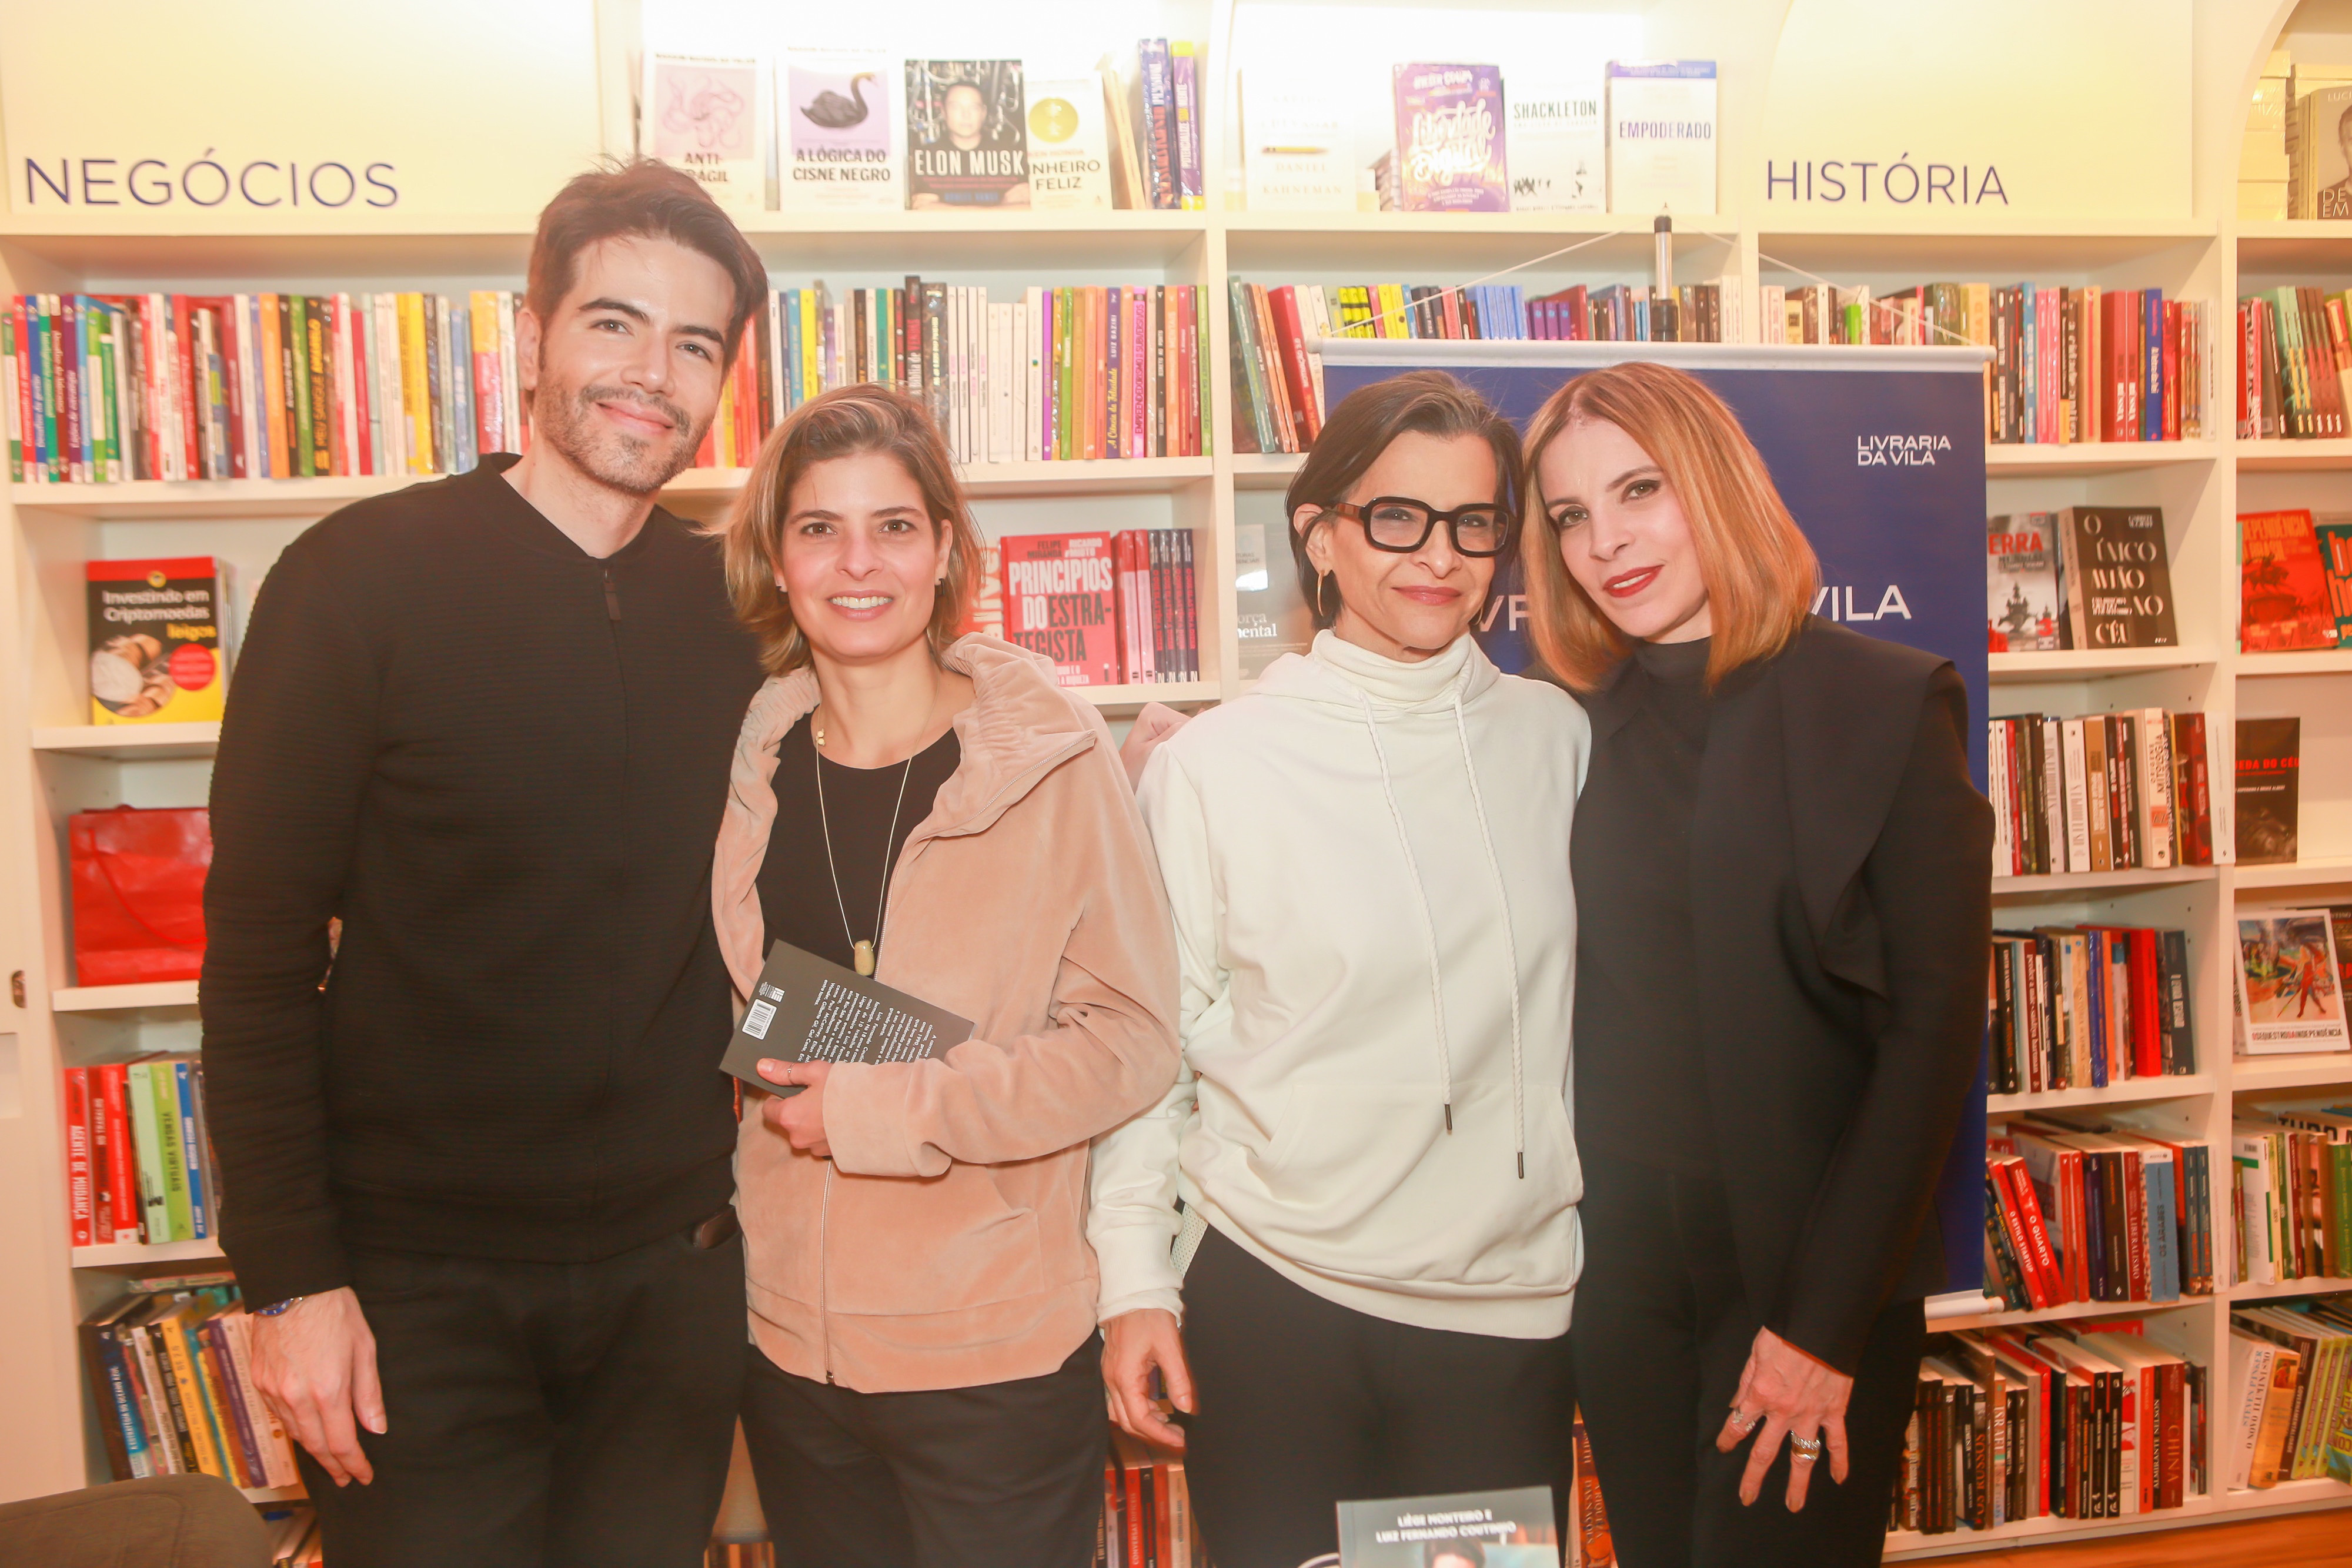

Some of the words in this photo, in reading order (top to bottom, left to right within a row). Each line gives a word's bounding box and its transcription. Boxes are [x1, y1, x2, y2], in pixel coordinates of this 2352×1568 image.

[2327, 91, 2352, 102] LUCI
[1513, 101, 1598, 119] SHACKLETON
[1412, 98, 1496, 149] Liberdade
[1619, 121, 1712, 140] EMPODERADO
[796, 151, 807, 162] A
[809, 145, 863, 163] LÓGICA
[864, 149, 886, 163] DO
[914, 150, 963, 176] ELON
[969, 149, 1025, 176] MUSK
[1410, 136, 1494, 187] Digital
[792, 168, 836, 182] CISNE
[840, 168, 891, 182] NEGRO
[1275, 162, 1327, 173] DANIEL
[25, 148, 399, 209] NEGÓCIOS
[1035, 177, 1082, 190] FELIZ
[1766, 152, 2009, 205] HISTÓRIA
[1262, 185, 1342, 195] KAHNEMAN
[1135, 304, 1144, 352] SUBVERSIVOS
[1108, 367, 1118, 403] Felicidade
[1202, 379, 1208, 389] DA
[312, 375, 326, 420] SANGUE
[1135, 358, 1144, 434] EMPREENDEDORISMO
[1110, 404, 1118, 412] da
[314, 422, 327, 447] MEU
[1107, 414, 1118, 439] Ciência
[1108, 439, 1117, 449] A
[1857, 434, 1952, 451] LIVRARIA
[1857, 451, 1886, 466] DA
[1888, 451, 1936, 466] VILA
[2083, 514, 2102, 536] O
[1037, 540, 1062, 549] FELIPE
[1068, 537, 1102, 547] RICARDO
[1988, 531, 2043, 556] ERRA
[2096, 537, 2157, 562] ÚNICO
[1027, 550, 1063, 559] MIRANDA
[102, 588, 184, 605] Investindo
[184, 590, 210, 603] em
[1810, 584, 1913, 621] VILA
[2133, 594, 2164, 617] NO
[103, 604, 211, 625] Criptomoedas
[1021, 594, 1048, 631] DO
[1048, 593, 1111, 628] ESTRA-
[1237, 613, 1268, 627] orça
[166, 623, 217, 641] leigos
[2037, 617, 2054, 637] 3
[2095, 619, 2131, 644] CÉU
[2263, 758, 2278, 769] DO
[2280, 755, 2300, 768] CÉU
[2027, 954, 2038, 981] perder
[820, 979, 828, 991] entre
[823, 982, 836, 1000] Wonder,
[813, 991, 824, 1005] tantos.
[836, 987, 847, 1004] música,
[858, 995, 867, 1008] Liège
[816, 1001, 827, 1019] Gilberto
[838, 1000, 850, 1018] Rio-São
[845, 992, 860, 1021] promoveram
[884, 1007, 894, 1024] grande
[811, 1019, 819, 1028] Gil,
[824, 1005, 840, 1034] trabalharam
[833, 1018, 842, 1032] Paulo
[849, 1008, 861, 1029] Monteiro
[918, 1021, 927, 1032] anos
[2029, 1009, 2039, 1038] saidiya
[820, 1034, 827, 1043] em
[837, 1021, 847, 1039] eventos
[878, 1022, 887, 1037] porte.
[908, 1027, 917, 1038] leva
[800, 1038, 811, 1052] Costa,
[823, 1037, 834, 1055] também
[842, 1035, 850, 1045] Luiz
[884, 1031, 899, 1059] profissionais
[912, 1033, 923, 1046] 1990,
[924, 1039, 934, 1058] carreira
[797, 1052, 805, 1062] Eric
[813, 1044, 823, 1058] shows
[829, 1044, 839, 1058] festas
[834, 1045, 846, 1064] Fernan
[899, 1045, 908, 1060] nome.
[906, 1046, 916, 1064] mudou
[2031, 1038, 2040, 1074] hartman
[163, 1112, 178, 1147] VENDAS
[71, 1125, 86, 1158] AGENTE
[72, 1161, 86, 1172] DE
[166, 1151, 182, 1192] VIRTUAIS
[72, 1176, 89, 1220] MUDANÇA
[2029, 1215, 2037, 1223] O
[2011, 1218, 2024, 1241] ESTILO
[2019, 1242, 2034, 1273] STARTUP
[2032, 1225, 2050, 1266] QUARTO
[2129, 1216, 2141, 1280] LIBERALISMO
[2159, 1242, 2167, 1257] OS
[2044, 1268, 2059, 1297] REICH
[110, 1366, 123, 1381] AZUL
[113, 1382, 128, 1403] OCEANO
[2241, 1389, 2255, 1427] STEVEN
[2248, 1350, 2264, 1387] PINKER
[2247, 1414, 2259, 1441] NOVO
[2253, 1351, 2271, 1412] ILUMINISMO
[120, 1403, 129, 1411] DO
[122, 1411, 138, 1444] ESTRATÉGIA
[1994, 1405, 2006, 1452] ISRAEL
[2153, 1399, 2161, 1442] NELSON
[1976, 1433, 1987, 1489] RUSSOS
[2167, 1424, 2180, 1483] CHINA
[2153, 1443, 2161, 1489] ALMIRANTE
[1583, 1480, 1593, 1497] DAS
[1129, 1492, 1138, 1522] DIFÍCEIS
[1426, 1509, 1485, 1526] MONTEIRO
[1485, 1509, 1493, 1522] E
[1584, 1498, 1596, 1544] NAÇÕES
[1375, 1528, 1401, 1544] LUIZ
[1401, 1526, 1458, 1542] FERNANDO
[1458, 1520, 1517, 1537] COUTINHO
[1130, 1523, 1139, 1565] CONVERSAS
